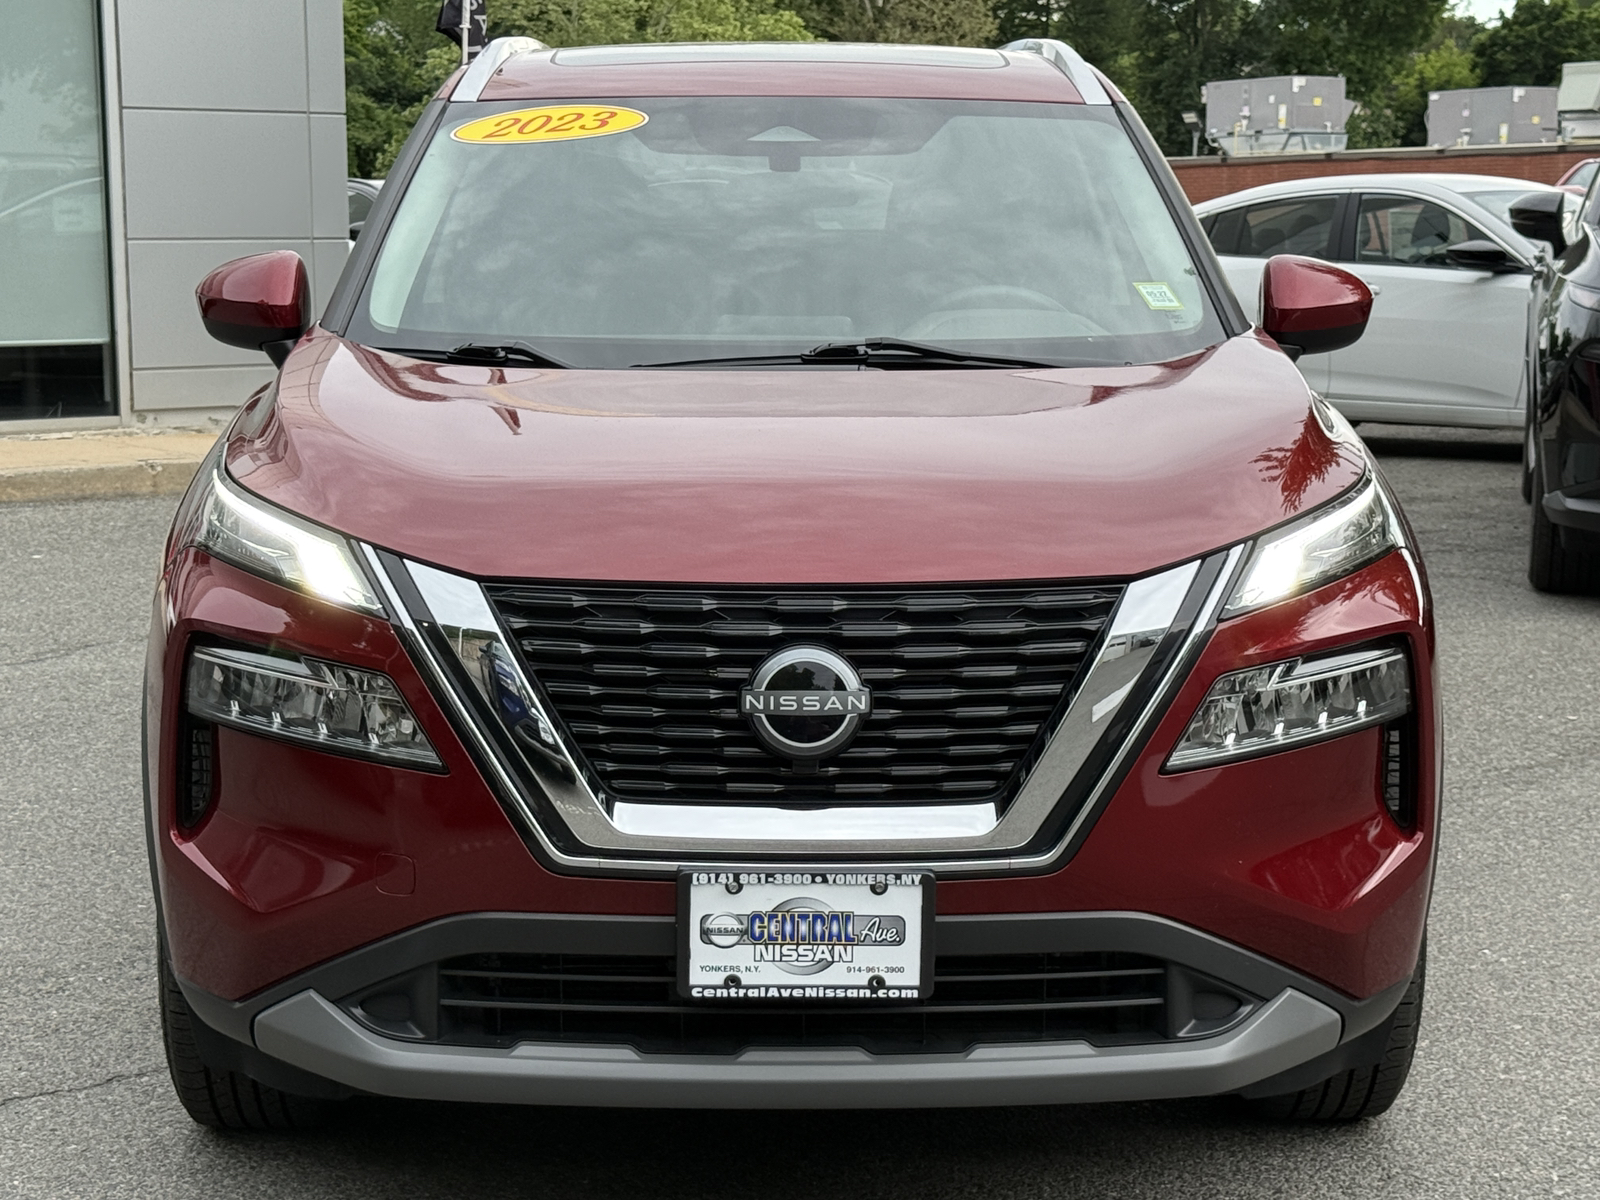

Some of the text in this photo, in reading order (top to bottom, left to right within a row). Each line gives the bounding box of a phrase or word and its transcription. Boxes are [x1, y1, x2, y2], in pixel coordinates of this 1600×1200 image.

[482, 111, 618, 139] 2023
[745, 694, 866, 711] NISSAN
[739, 873, 812, 885] 961-3900
[706, 926, 744, 934] NISSAN
[748, 911, 901, 945] CENTRAL Ave.
[754, 944, 853, 962] NISSAN
[699, 965, 761, 973] YONKERS, N.Y.
[691, 986, 919, 998] CentralAveNissan.com
